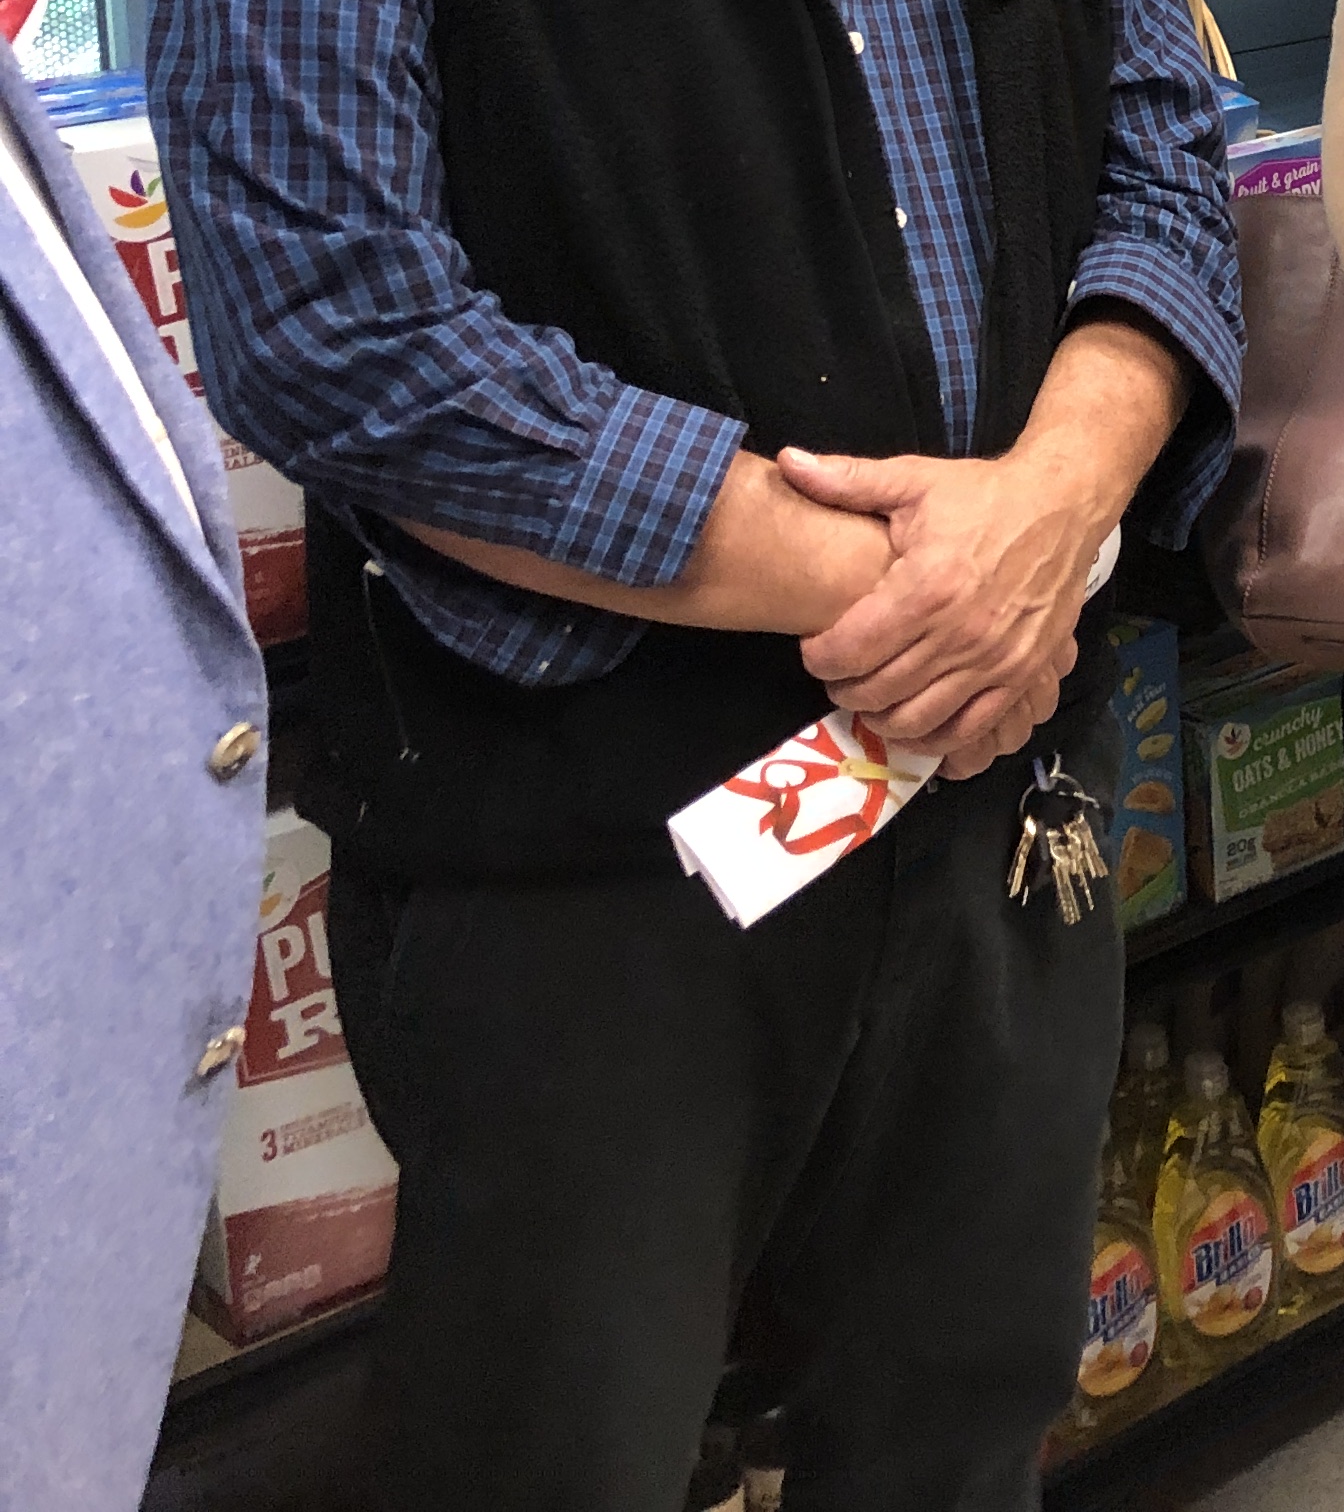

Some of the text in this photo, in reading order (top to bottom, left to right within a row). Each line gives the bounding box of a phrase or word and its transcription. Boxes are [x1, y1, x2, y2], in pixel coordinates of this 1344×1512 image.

[1271, 171, 1281, 188] &
[1284, 162, 1319, 190] grain
[1252, 703, 1324, 752] crunchy
[1231, 754, 1275, 793] OATS
[1278, 747, 1292, 772] &
[1294, 717, 1344, 763] HONEY
[260, 1128, 278, 1162] 3
[1194, 1215, 1258, 1283] Brillo
